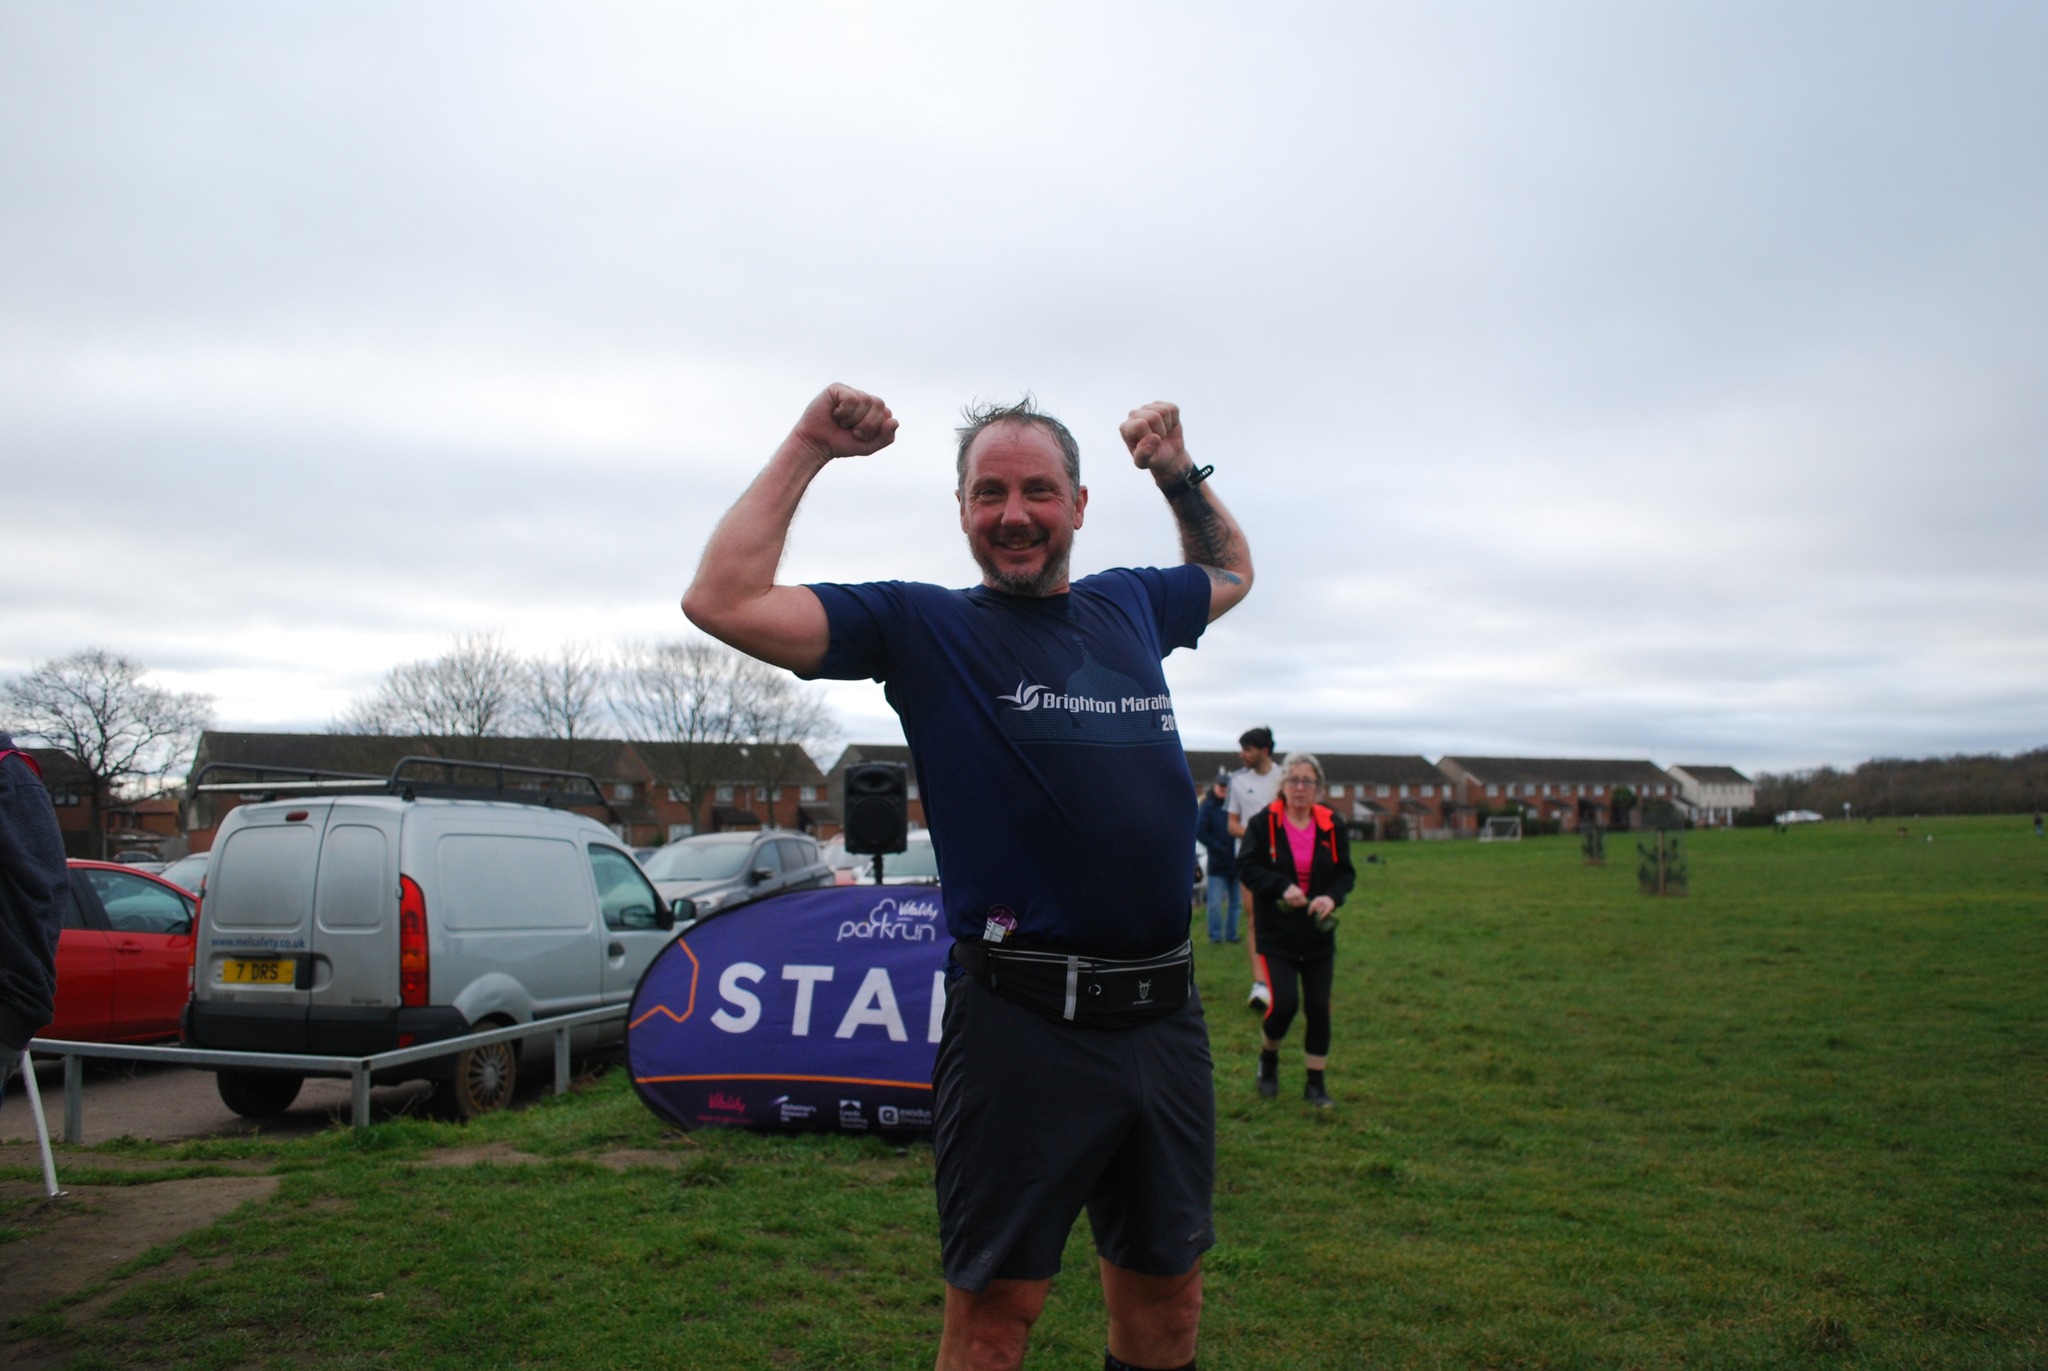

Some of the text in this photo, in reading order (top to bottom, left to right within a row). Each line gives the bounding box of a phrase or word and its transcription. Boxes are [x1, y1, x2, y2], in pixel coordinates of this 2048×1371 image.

[1043, 693, 1116, 713] Brighton
[898, 900, 938, 922] Vitality
[836, 912, 936, 942] parkrun
[236, 963, 279, 980] 7 DRS
[710, 962, 946, 1044] STA
